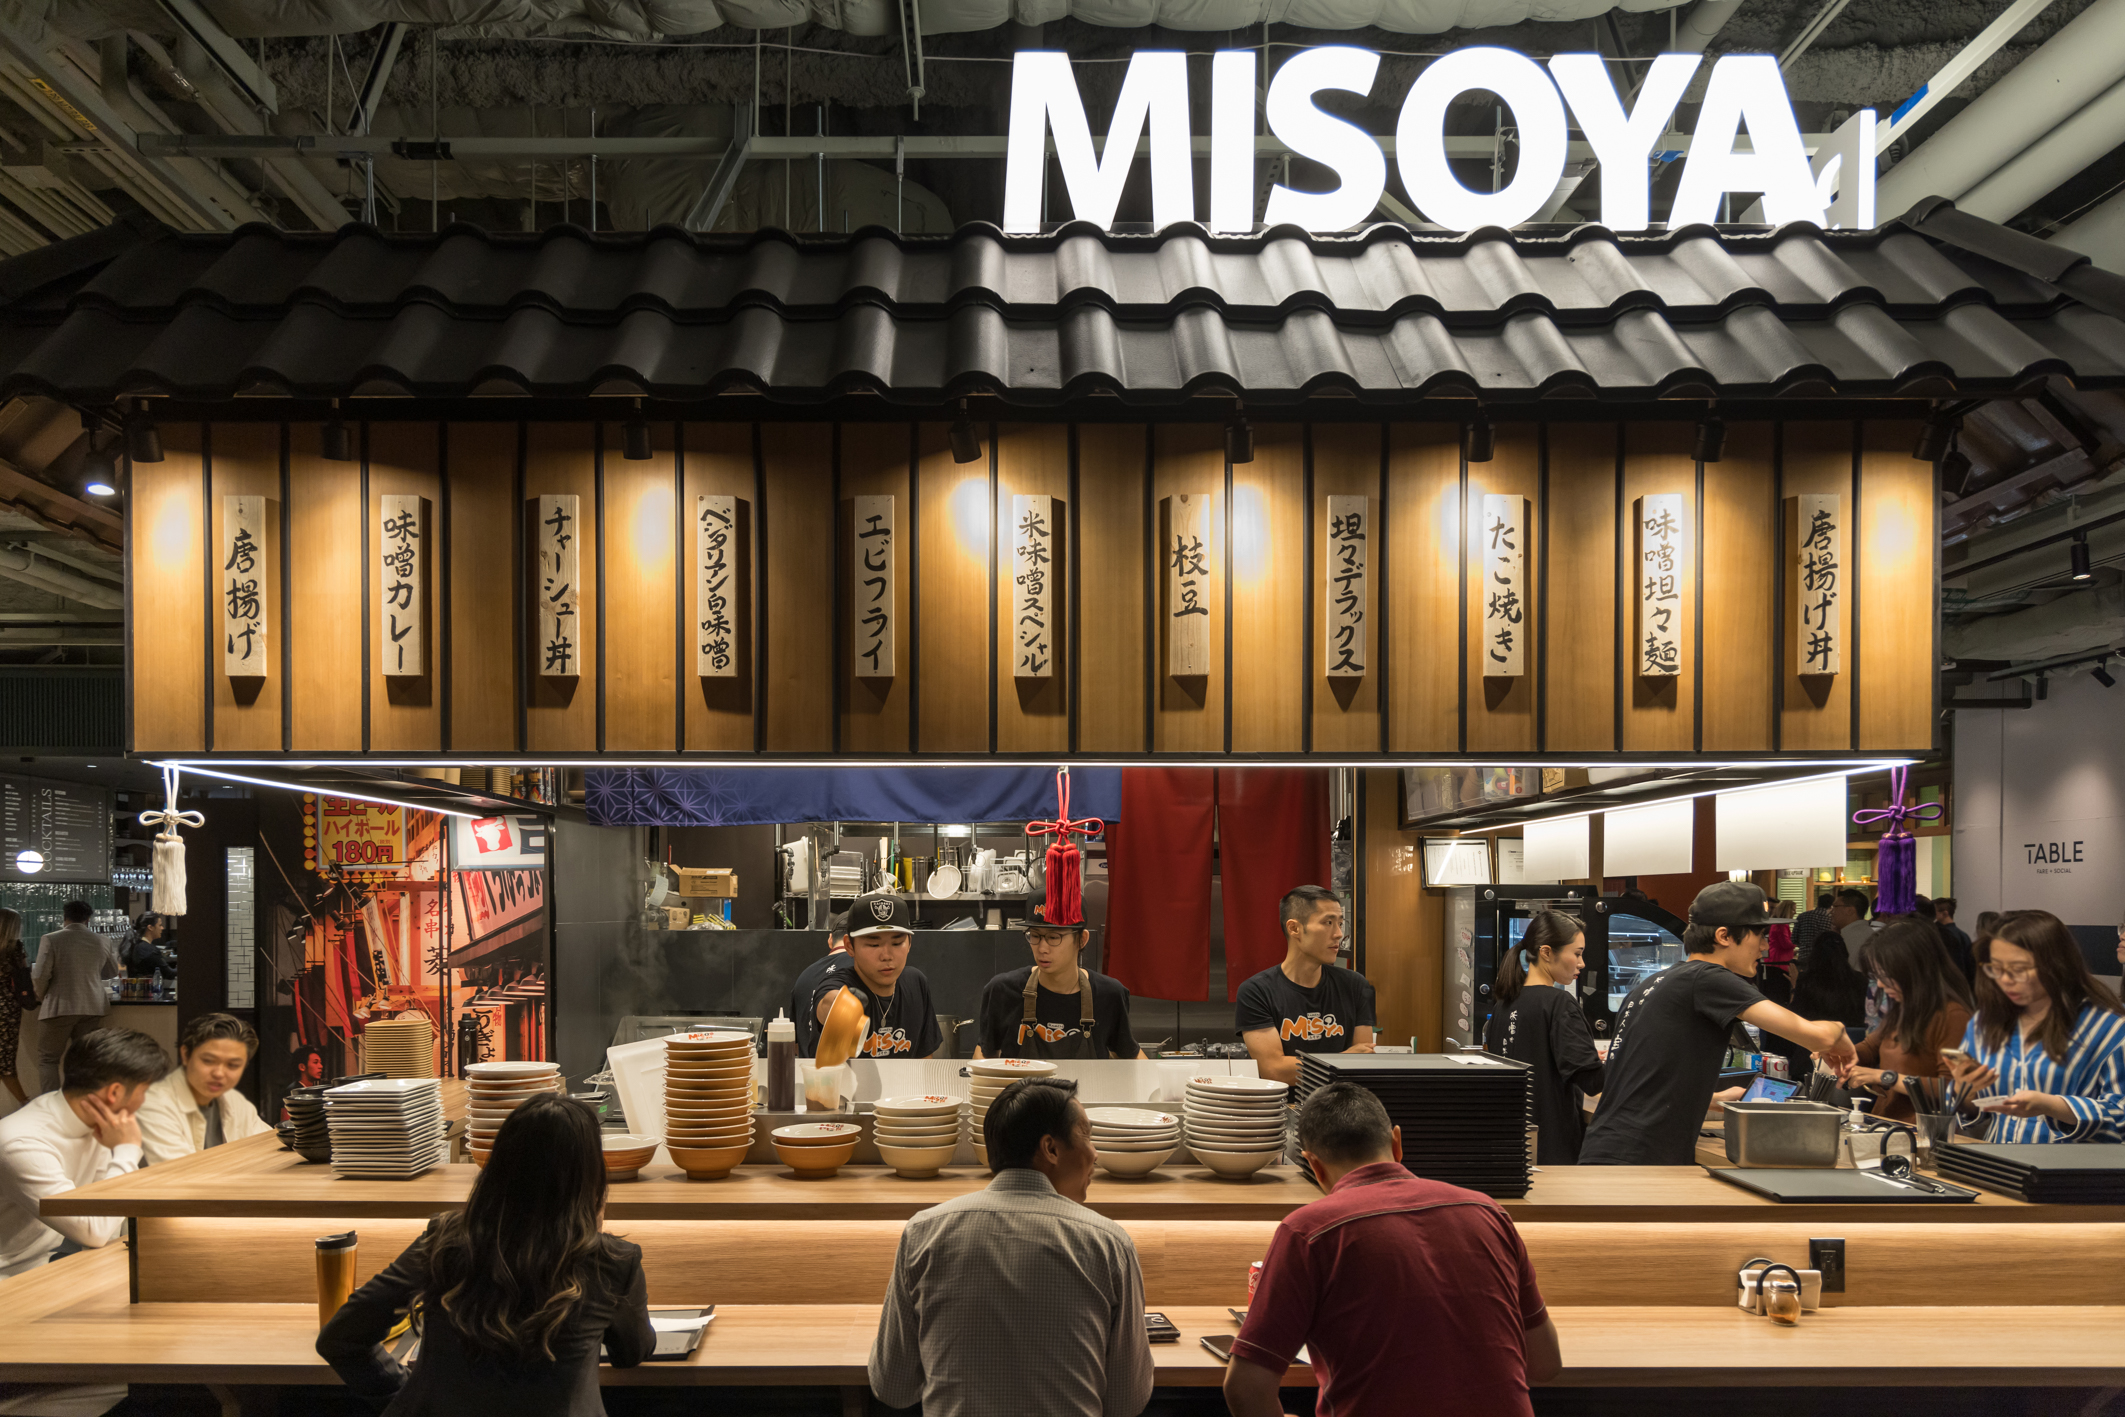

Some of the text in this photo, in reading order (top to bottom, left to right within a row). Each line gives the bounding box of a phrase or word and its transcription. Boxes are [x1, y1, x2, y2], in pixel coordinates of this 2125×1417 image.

[1003, 46, 1829, 234] MISOYA
[225, 527, 260, 660] 唐揚げ
[382, 509, 420, 673] 味噌カレー
[544, 506, 575, 675] チャーシュー丼
[700, 507, 732, 670] ベジタリアン白味噌
[858, 514, 891, 671] エビフライ
[1016, 509, 1051, 674] 米味噌スペシャル
[1170, 534, 1209, 618] 枝豆
[1487, 515, 1523, 663] たこ焼き
[1802, 509, 1839, 671] 唐揚げ丼
[41, 788, 53, 873] COCKTAILS
[324, 818, 400, 838] ハイボール
[332, 840, 394, 864] 180円
[2024, 841, 2084, 865] TABLE
